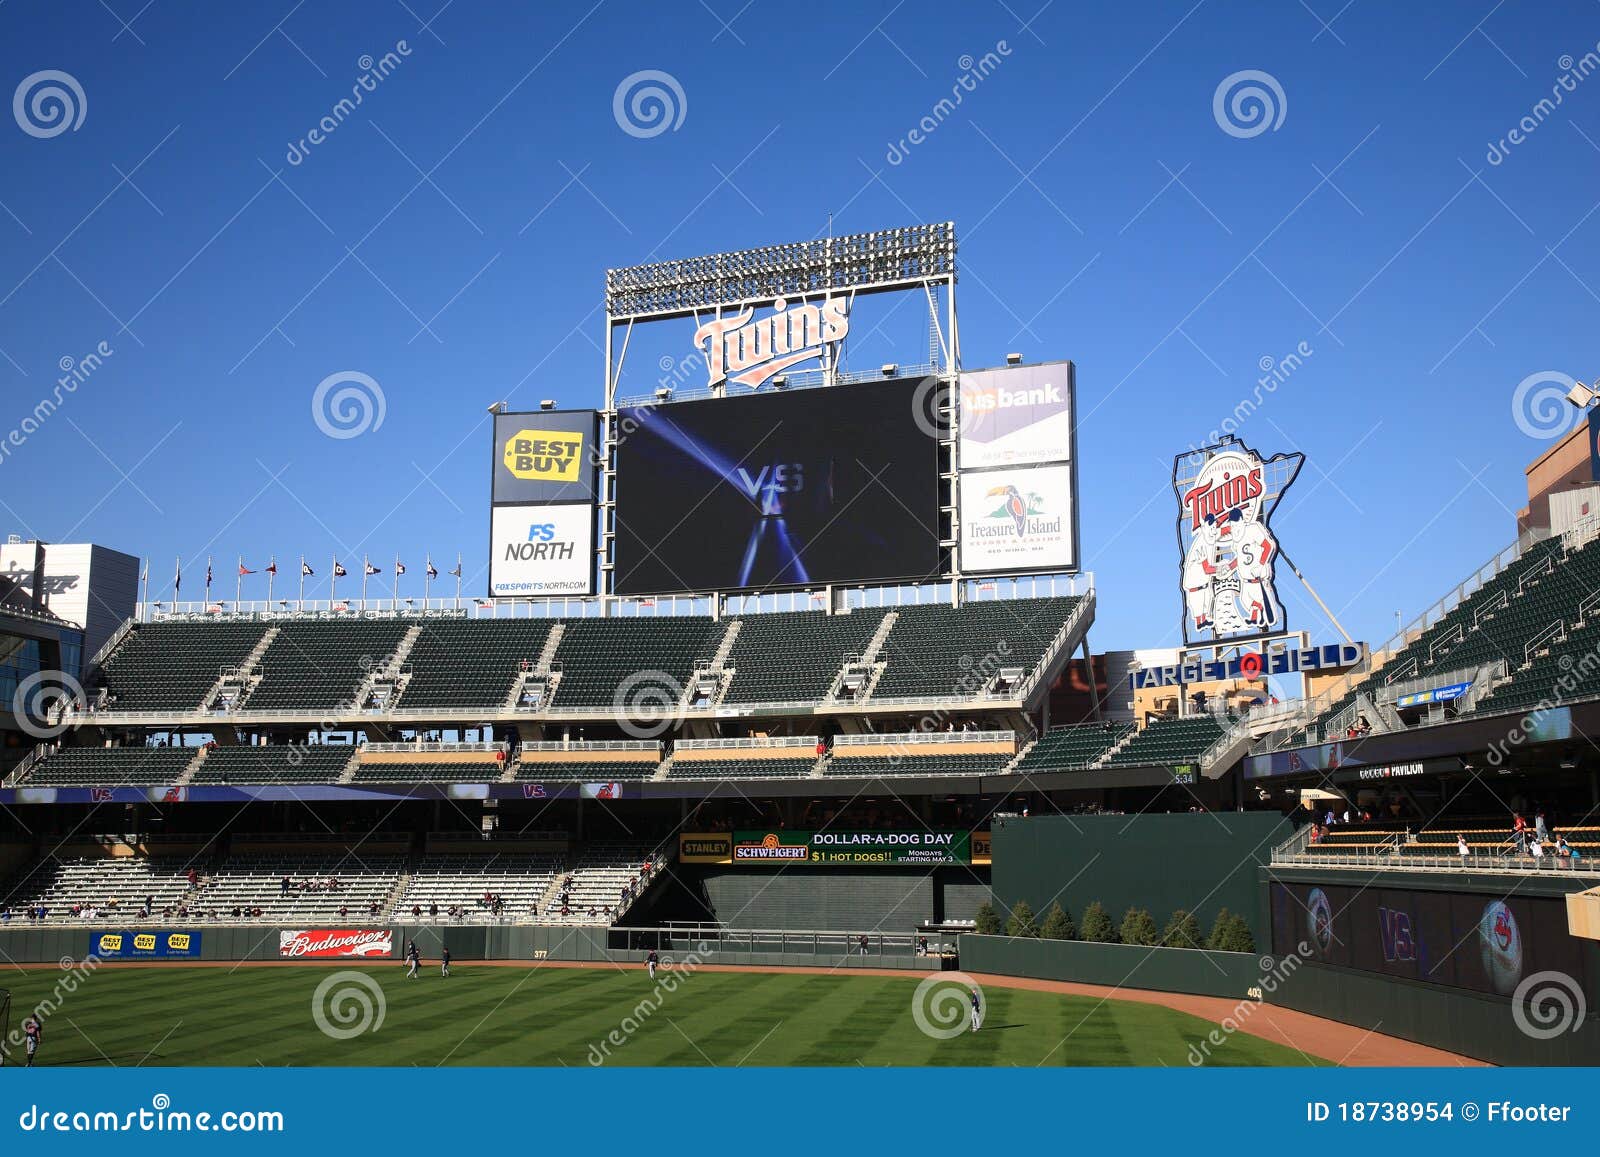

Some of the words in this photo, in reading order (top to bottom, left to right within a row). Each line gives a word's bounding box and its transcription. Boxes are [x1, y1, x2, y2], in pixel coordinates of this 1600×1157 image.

[693, 298, 849, 389] Twins
[514, 438, 580, 457] BEST
[515, 456, 573, 474] BUY
[1184, 467, 1263, 532] Twins
[528, 523, 555, 541] FS
[967, 521, 1015, 538] Treasure
[1027, 516, 1061, 534] Island
[504, 541, 574, 561] NORTH
[1127, 656, 1238, 689] TARGET
[1267, 643, 1362, 674] FIELD
[1174, 766, 1192, 774] TIME
[1391, 763, 1424, 777] PAVILION
[1175, 774, 1193, 784] 5:34
[813, 833, 920, 845] DOLLAR-A-DOG
[924, 833, 954, 844] DAY
[686, 843, 727, 853] STANLEY
[736, 847, 806, 858] SCHWEIGERT
[811, 851, 826, 862] $1
[829, 853, 851, 862] HOT
[854, 852, 892, 862] DOGS!!
[897, 855, 931, 863] STARTING
[285, 930, 385, 957] Budweiser
[534, 950, 548, 959] 377
[1247, 987, 1262, 998] 403
